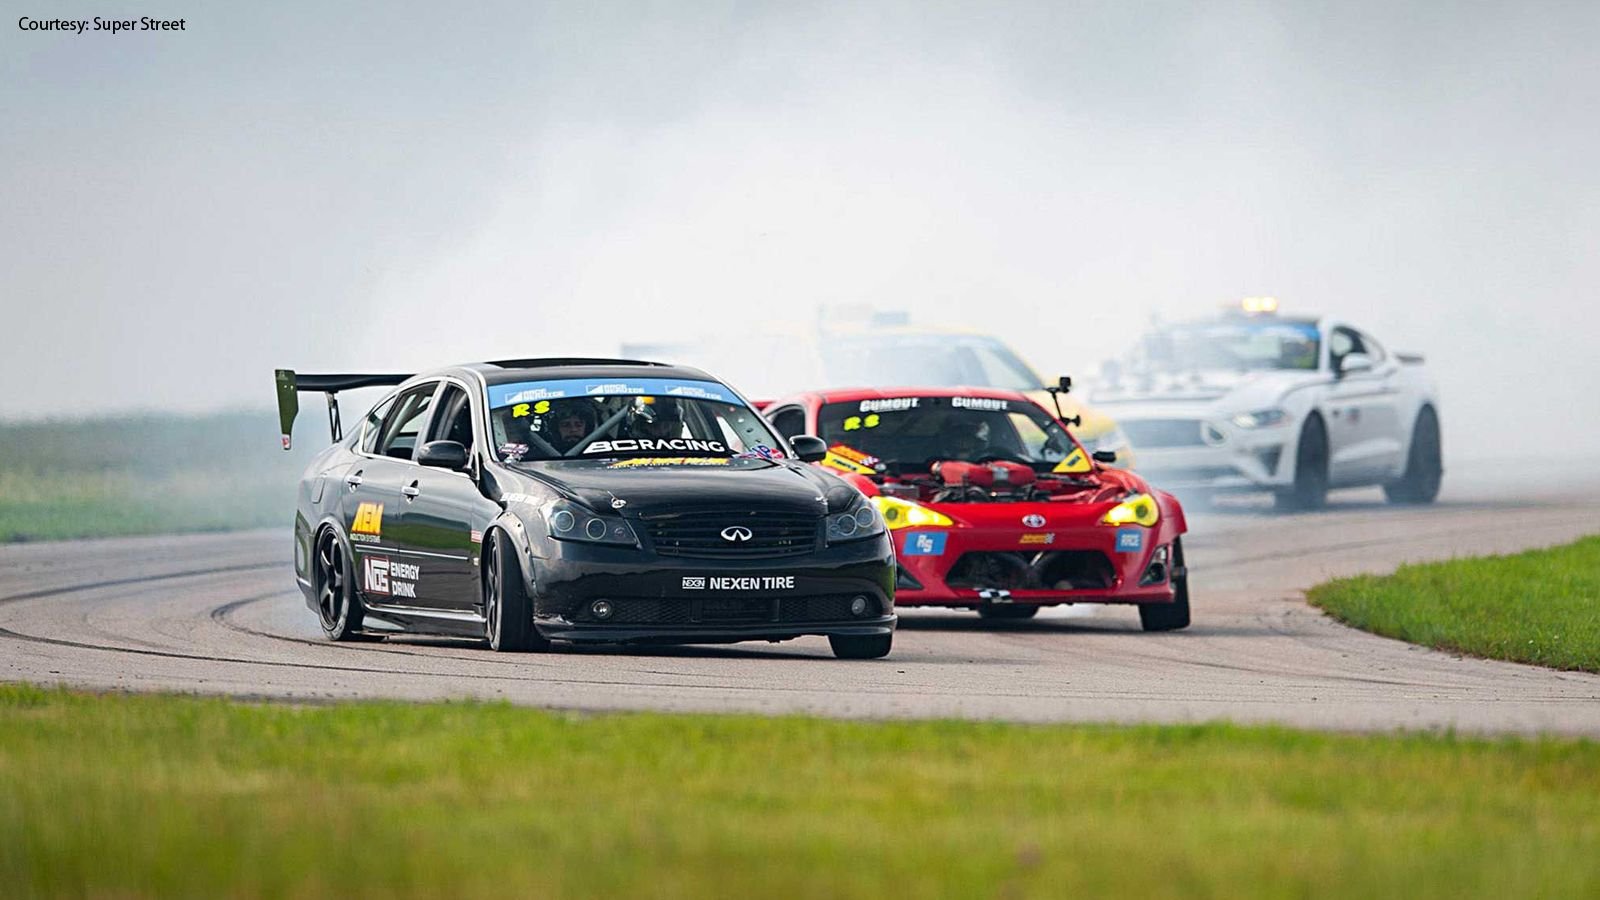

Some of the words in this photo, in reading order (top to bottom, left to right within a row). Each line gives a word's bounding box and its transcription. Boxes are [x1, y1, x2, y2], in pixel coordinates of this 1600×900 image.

[390, 561, 420, 580] ENERGY
[391, 580, 416, 598] DRINK
[709, 577, 760, 590] NEXEN
[762, 576, 795, 589] TIRE
